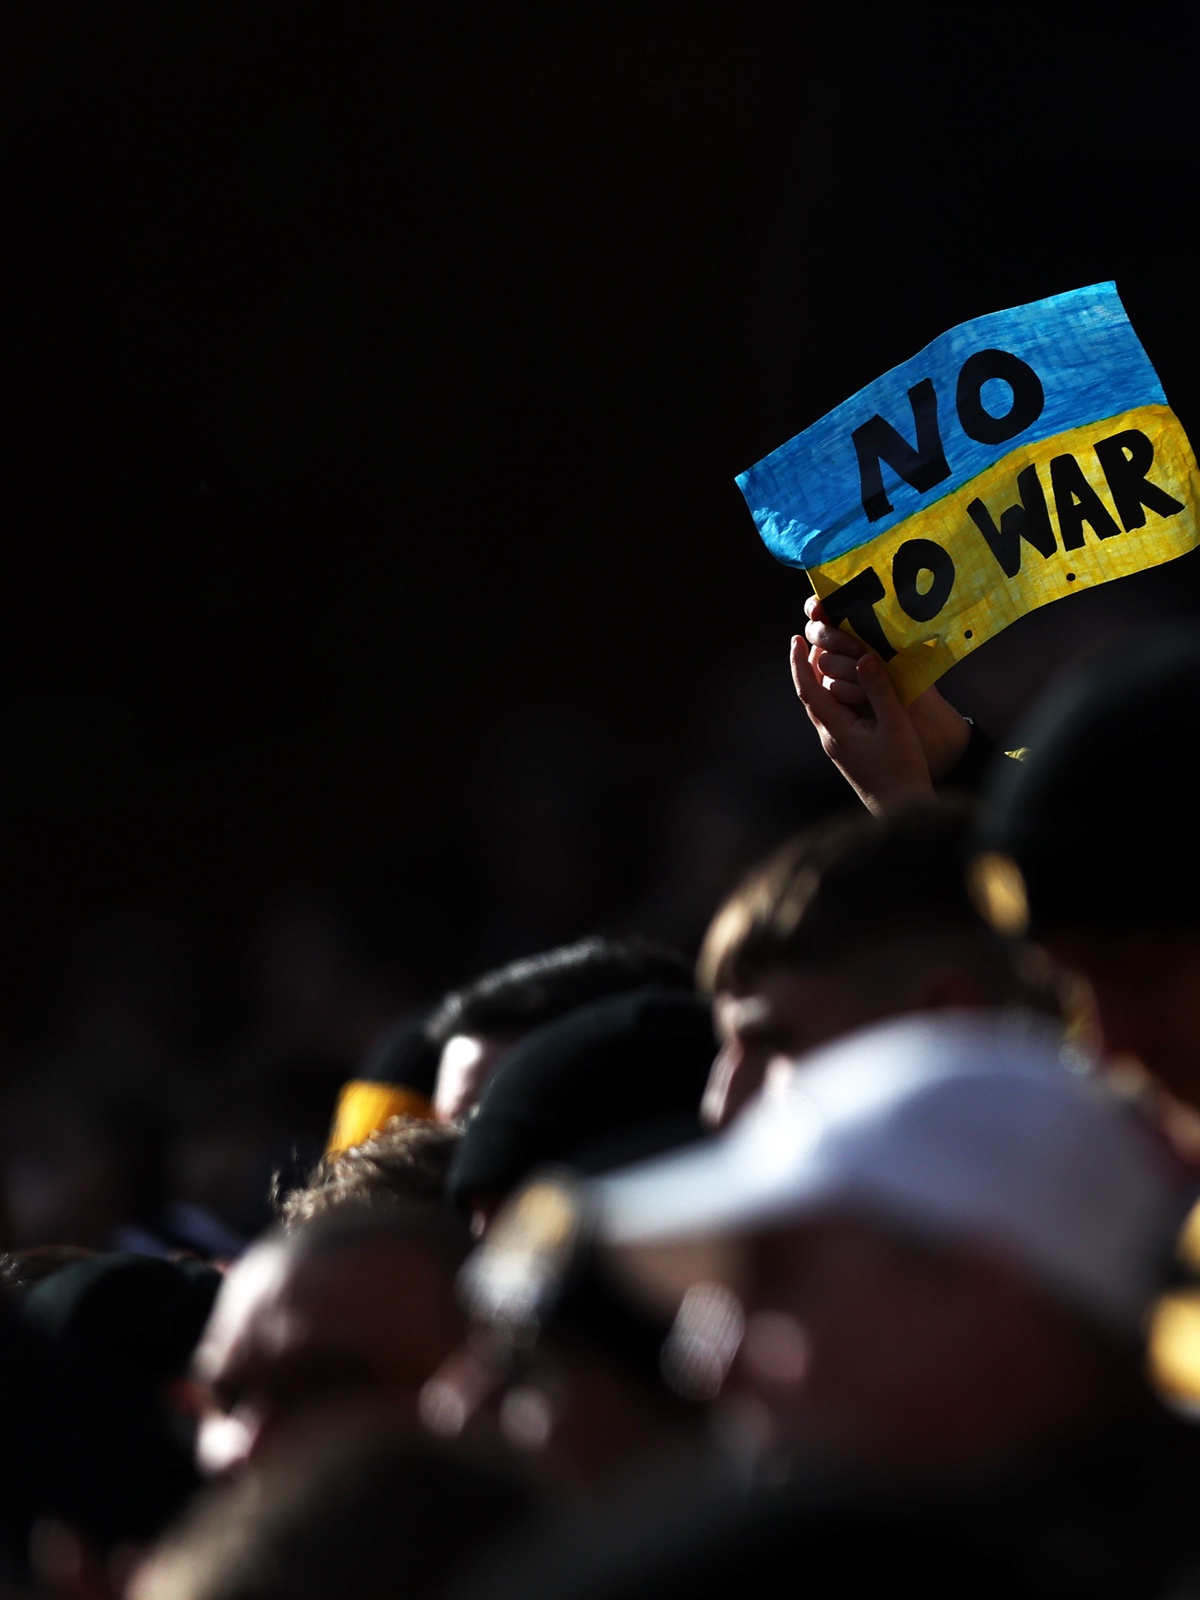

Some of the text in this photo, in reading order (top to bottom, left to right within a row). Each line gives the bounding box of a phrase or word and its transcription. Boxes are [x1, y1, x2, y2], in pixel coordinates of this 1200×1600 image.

[851, 348, 1045, 523] NO
[820, 428, 1186, 662] TO WAR
